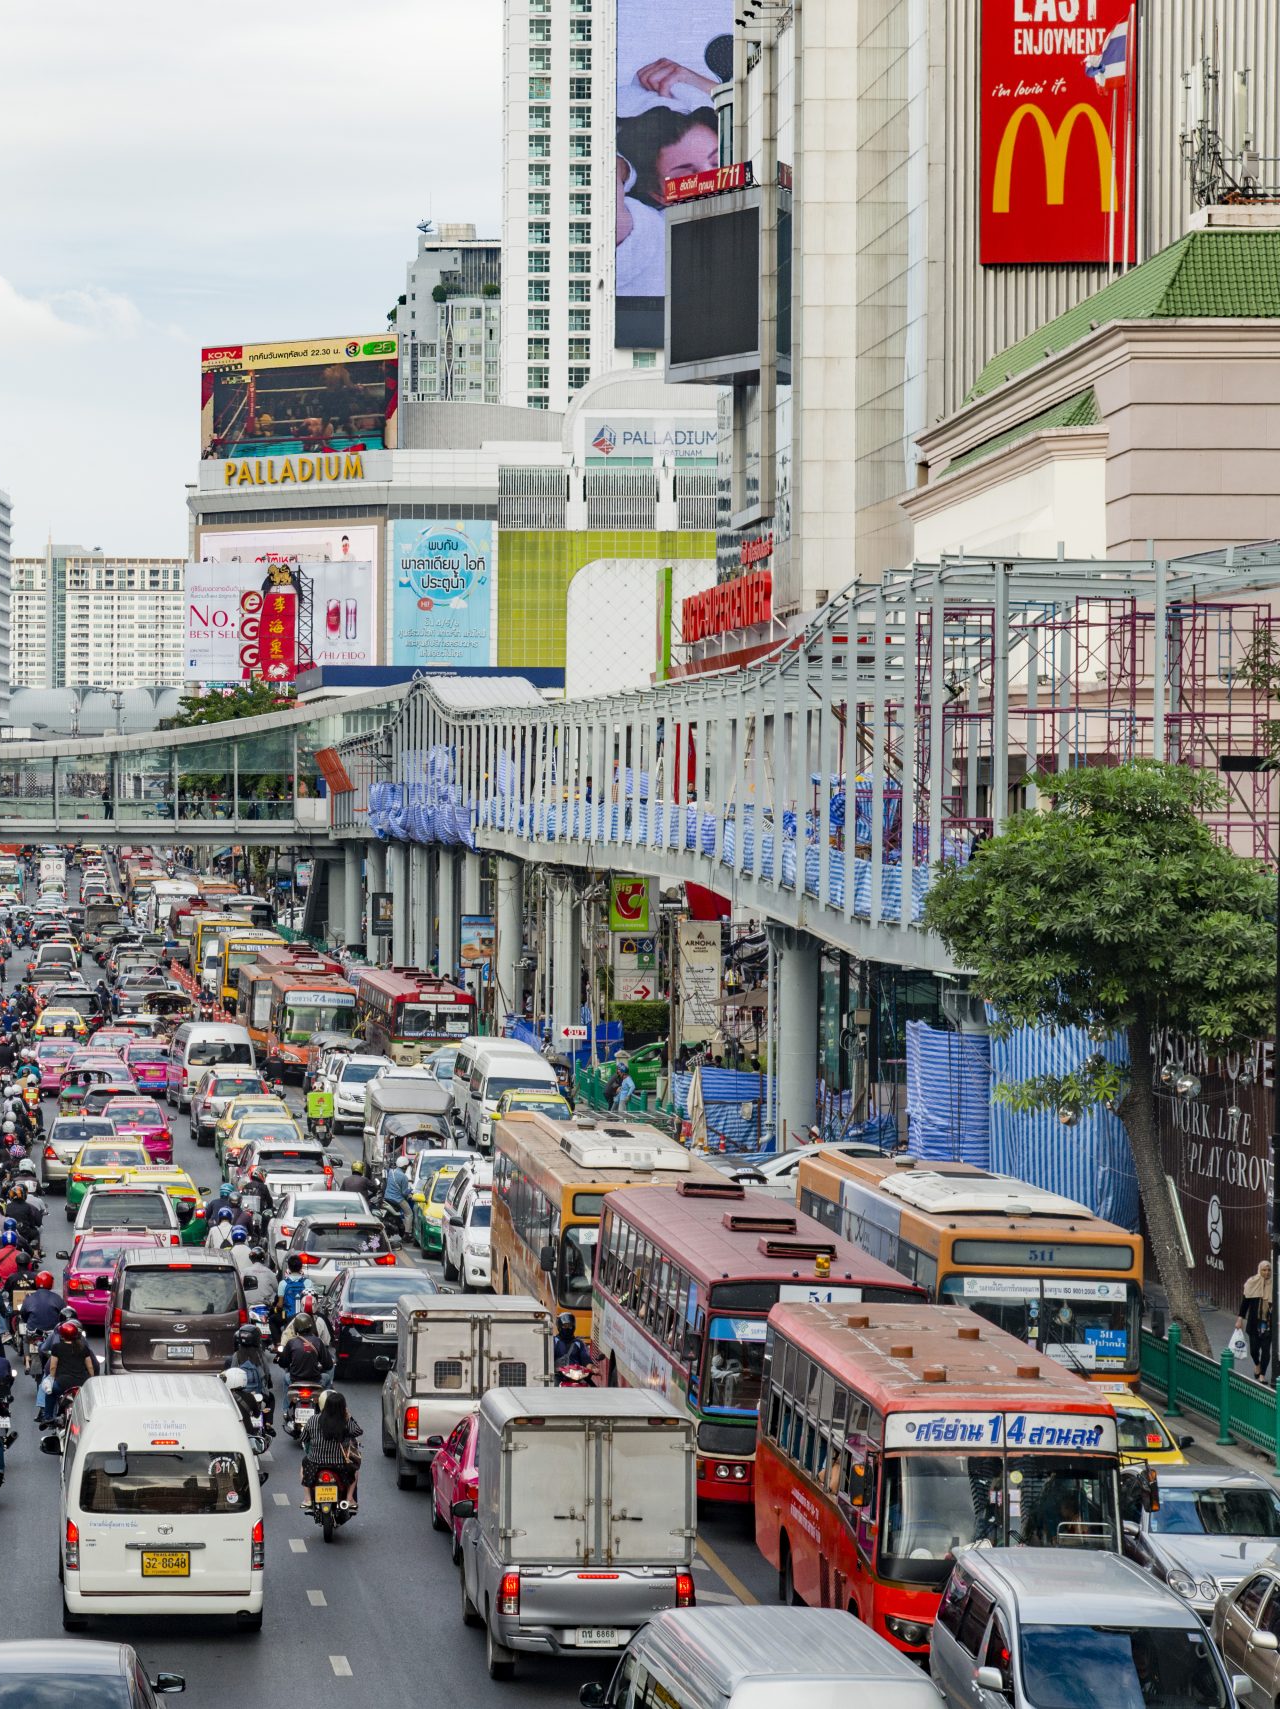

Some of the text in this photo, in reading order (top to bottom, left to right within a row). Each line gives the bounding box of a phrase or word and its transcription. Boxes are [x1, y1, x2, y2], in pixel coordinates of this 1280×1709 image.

[1014, 28, 1106, 55] ENJOYMENT
[992, 83, 1011, 97] i'm
[1014, 80, 1047, 97] lovin'
[716, 165, 740, 189] 1711
[207, 351, 237, 359] KOTV
[310, 349, 331, 357] 22.30
[622, 430, 718, 446] PALLADIUM
[224, 454, 364, 486] PALLADIUM
[401, 554, 485, 572] พาลาเดียม ไอที
[190, 630, 214, 638] BEST
[318, 651, 366, 660] SHISEIDO
[615, 882, 633, 895] Big
[313, 994, 326, 1006] 74
[1029, 1249, 1054, 1263] 511
[915, 1415, 1102, 1450] ศรีย่าน 14 สวนลุม
[597, 1630, 615, 1638] 6868
